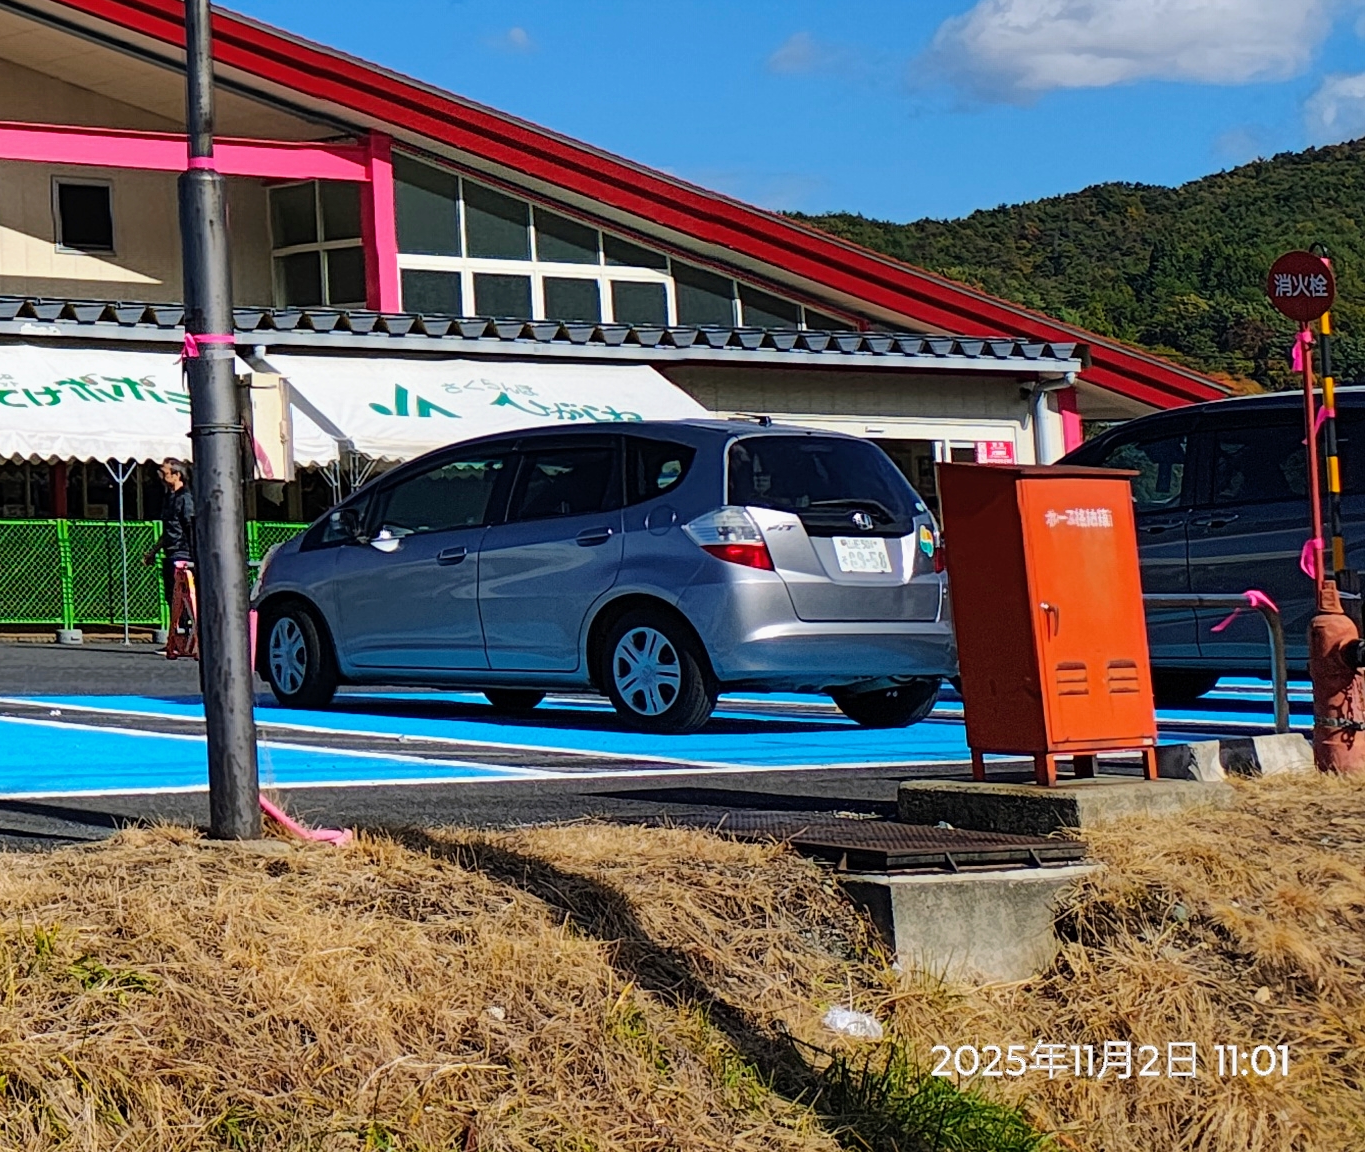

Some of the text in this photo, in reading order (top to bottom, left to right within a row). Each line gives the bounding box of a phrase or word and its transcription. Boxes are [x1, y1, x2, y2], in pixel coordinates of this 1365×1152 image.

[1274, 273, 1329, 297] 消火栓
[441, 378, 539, 396] さくらんぼ
